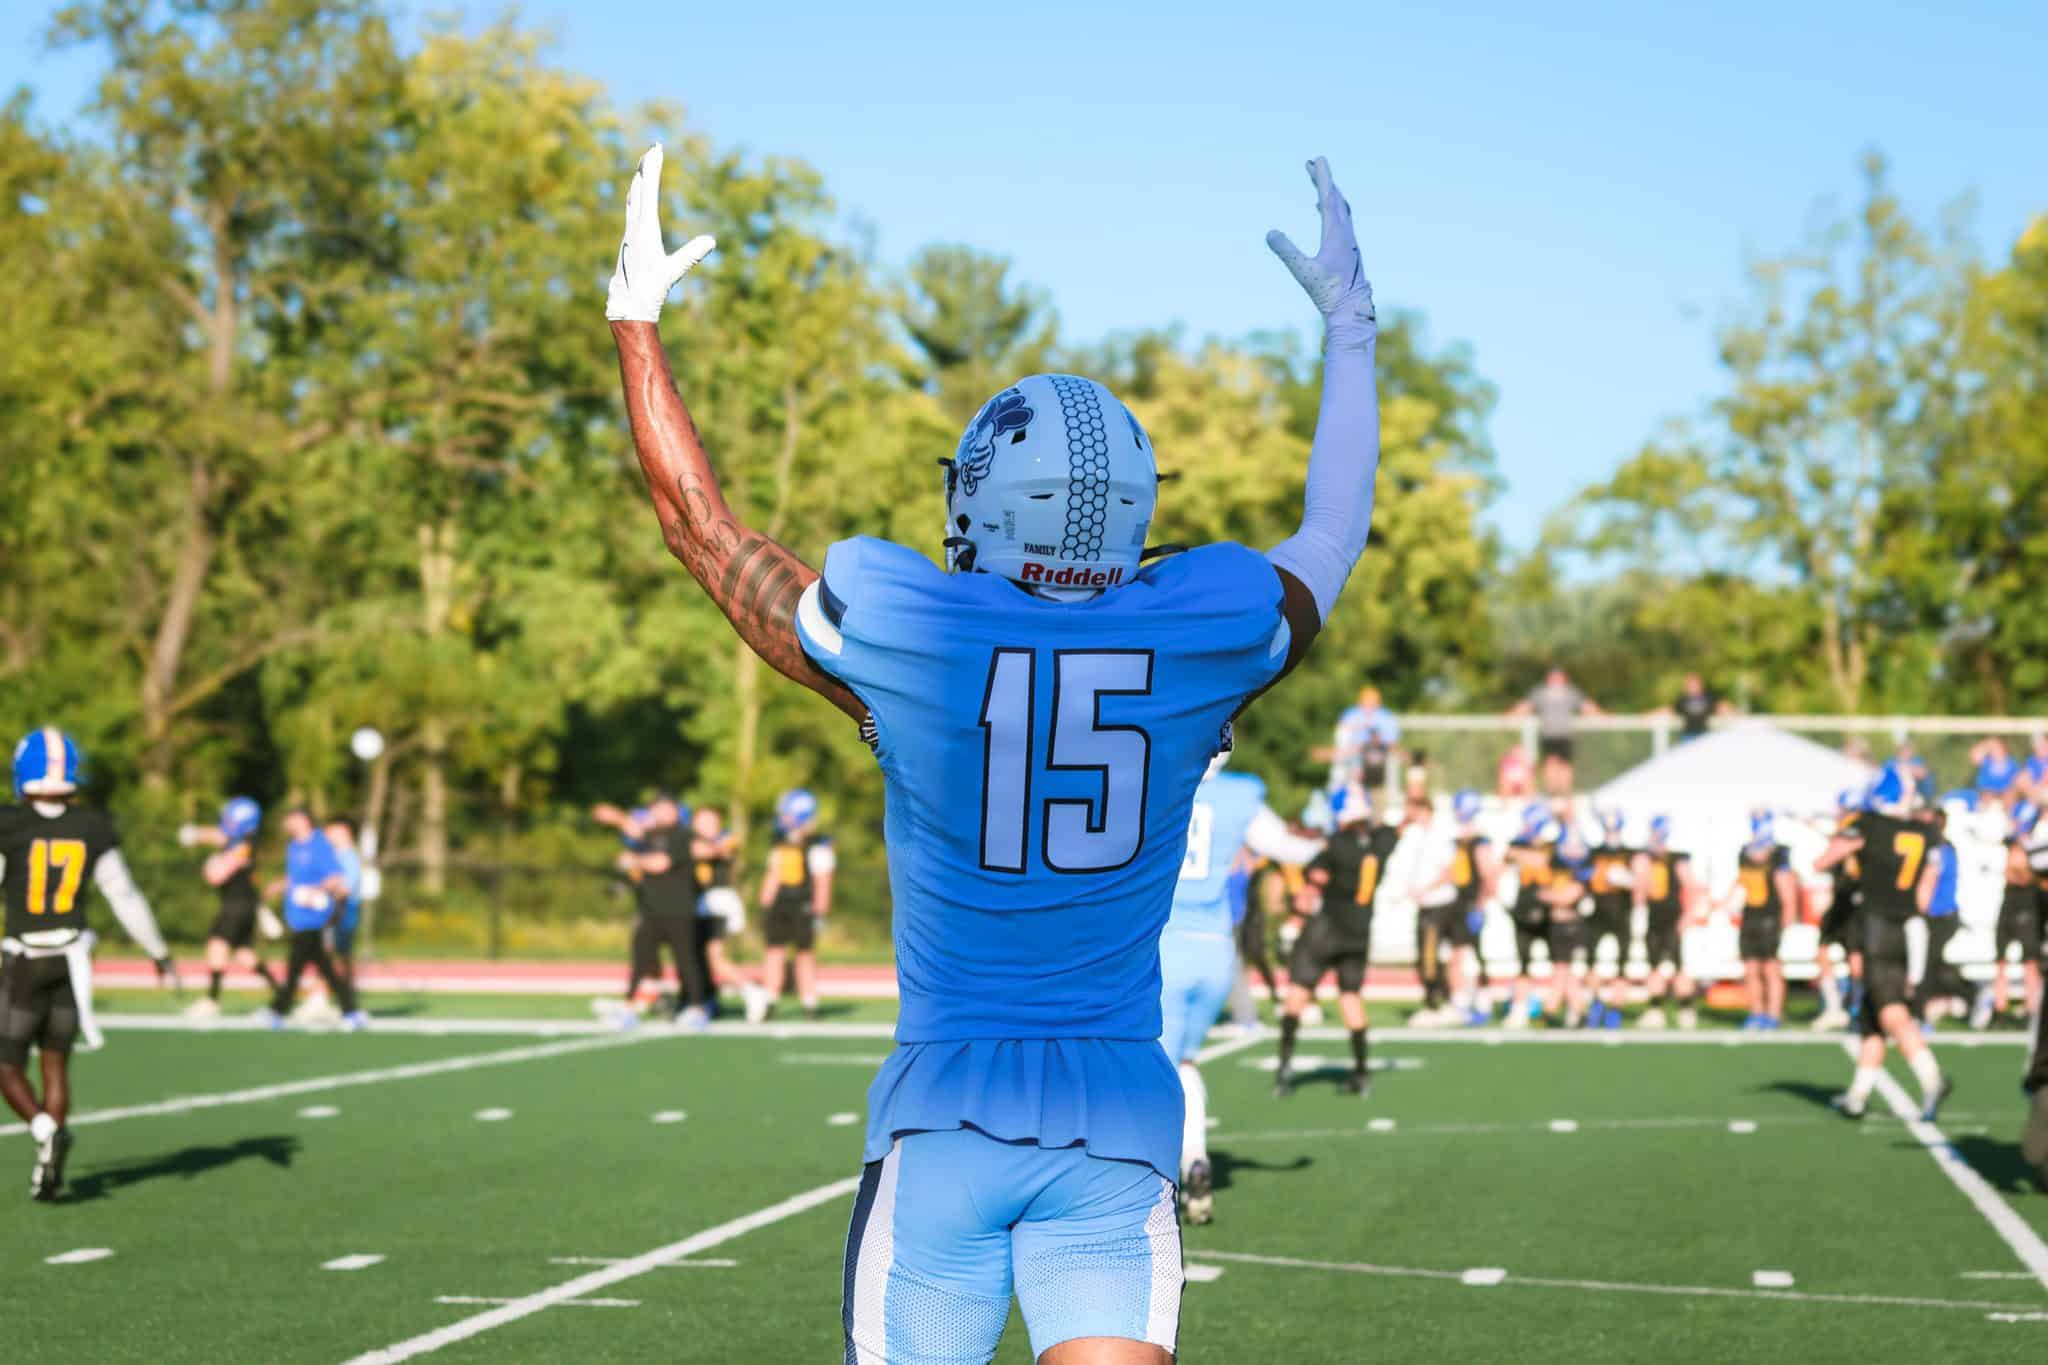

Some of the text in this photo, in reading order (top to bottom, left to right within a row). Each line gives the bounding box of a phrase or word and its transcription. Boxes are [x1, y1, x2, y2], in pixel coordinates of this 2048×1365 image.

[1021, 562, 1123, 586] Riddell
[1024, 542, 1057, 556] FAMILY
[977, 646, 1156, 875] 15
[27, 838, 86, 914] 17
[1893, 832, 1925, 890] 7
